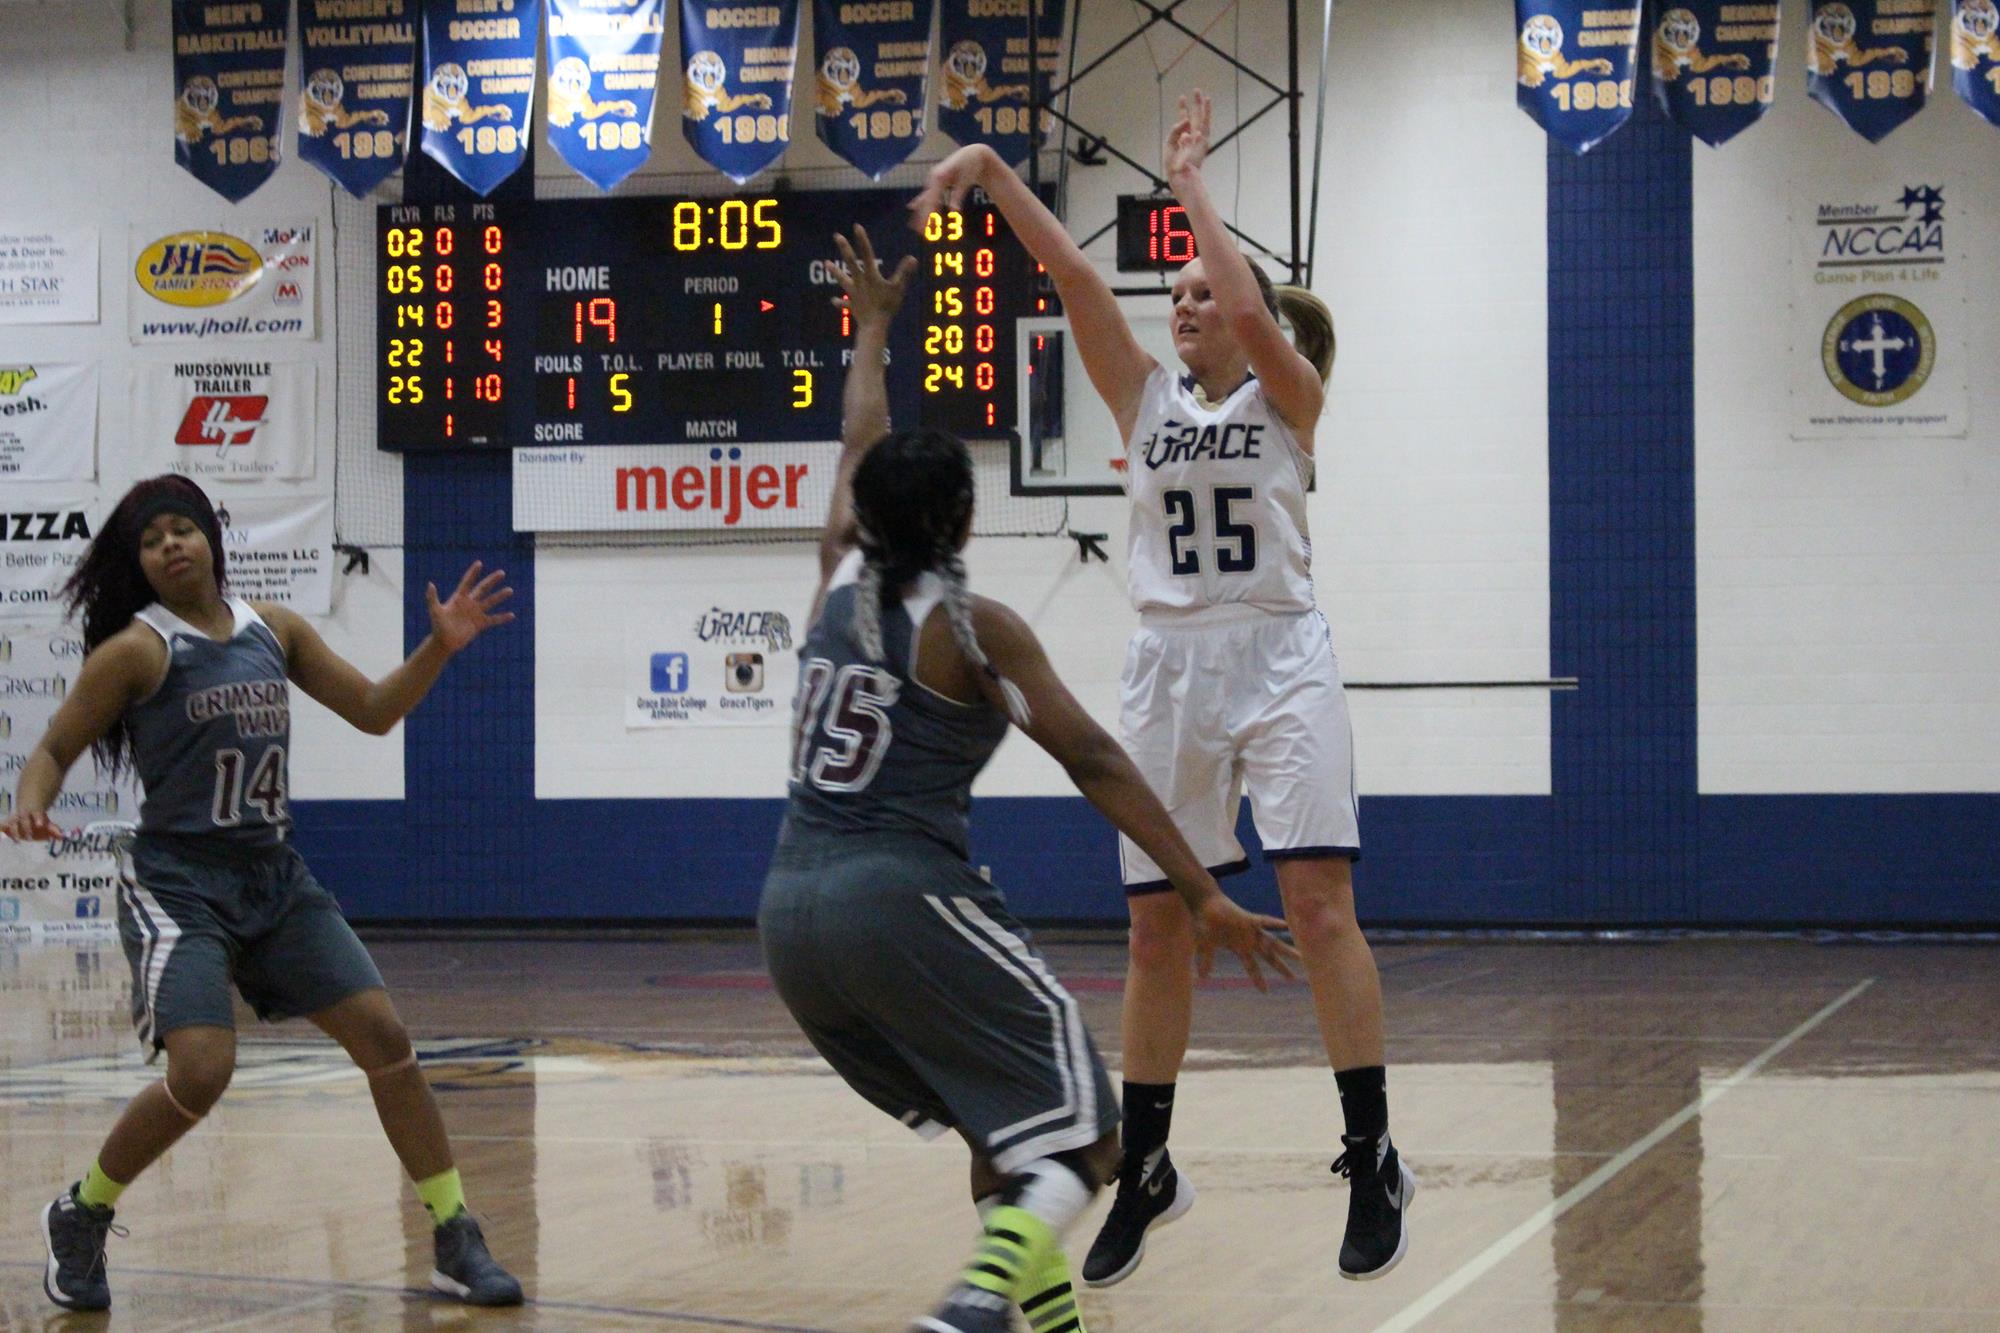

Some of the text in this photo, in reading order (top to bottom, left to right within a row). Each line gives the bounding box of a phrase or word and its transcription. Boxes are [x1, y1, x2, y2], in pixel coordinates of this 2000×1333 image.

[706, 6, 781, 29] SOCCER
[840, 2, 914, 25] SOCCER
[306, 23, 416, 47] VOLLEYBALL
[449, 17, 521, 41] SOCCER
[578, 121, 647, 151] 198
[434, 205, 456, 221] FLS
[472, 204, 495, 220] PTS
[1818, 203, 1879, 218] Member
[673, 198, 782, 252] 8:05
[924, 211, 964, 242] 03
[985, 213, 994, 237] 1
[1148, 206, 1195, 262] 16
[387, 228, 424, 257] 02
[436, 227, 453, 255] 0
[484, 225, 502, 254] 0
[1823, 225, 1943, 257] NCCAA
[934, 251, 964, 277] 14
[975, 248, 994, 278] 0
[21, 276, 60, 293] STAR
[154, 278, 196, 291] FAMILY
[387, 265, 424, 294] 05
[436, 263, 453, 292] 0
[484, 262, 502, 291] 0
[545, 266, 611, 292] HOME
[684, 276, 739, 294] PERIOD
[1814, 273, 1857, 286] Game
[1862, 270, 1894, 282] Plan
[1912, 269, 1940, 281] Life
[487, 299, 502, 328] 3
[934, 286, 964, 317] 15
[975, 286, 994, 315] 0
[143, 317, 302, 338] www.jhoil.com
[397, 304, 424, 328] 14
[436, 301, 453, 329] 0
[574, 297, 616, 344] 19
[713, 302, 723, 336] 1
[484, 338, 502, 363] 4
[924, 324, 964, 355] 20
[975, 324, 994, 353] 0
[387, 338, 424, 367] 22
[445, 340, 454, 364] 1
[535, 354, 644, 374] FOULS T.O.L.
[657, 350, 765, 371] PLAYER FOUL
[781, 349, 825, 368] T.O.L.
[174, 362, 272, 377] HUDSONVILLE
[924, 363, 964, 393] 24
[975, 362, 994, 391] 0
[194, 379, 251, 393] TRAILER
[387, 375, 424, 404] 25
[445, 376, 454, 400] 1
[474, 373, 502, 402] 10
[567, 376, 576, 410] 1
[609, 373, 632, 412] 5
[792, 369, 812, 408] 3
[0, 396, 48, 416] esh.
[985, 402, 994, 427] 1
[445, 413, 454, 438] 1
[534, 423, 584, 442] SCORE
[685, 420, 738, 439] MATCH
[519, 450, 585, 465] Donated By
[1142, 419, 1265, 471] GRACE
[615, 447, 809, 525] meijer
[0, 511, 91, 541] IZZA
[1161, 484, 1260, 578] 25
[6, 551, 48, 568] Better
[229, 547, 319, 564] Systems LLC
[0, 588, 49, 603] .com
[694, 606, 771, 642] GRACE
[637, 697, 658, 709] Grace
[650, 709, 689, 720] Athletics
[211, 743, 286, 828] 14
[0, 871, 113, 893] race Tiger
